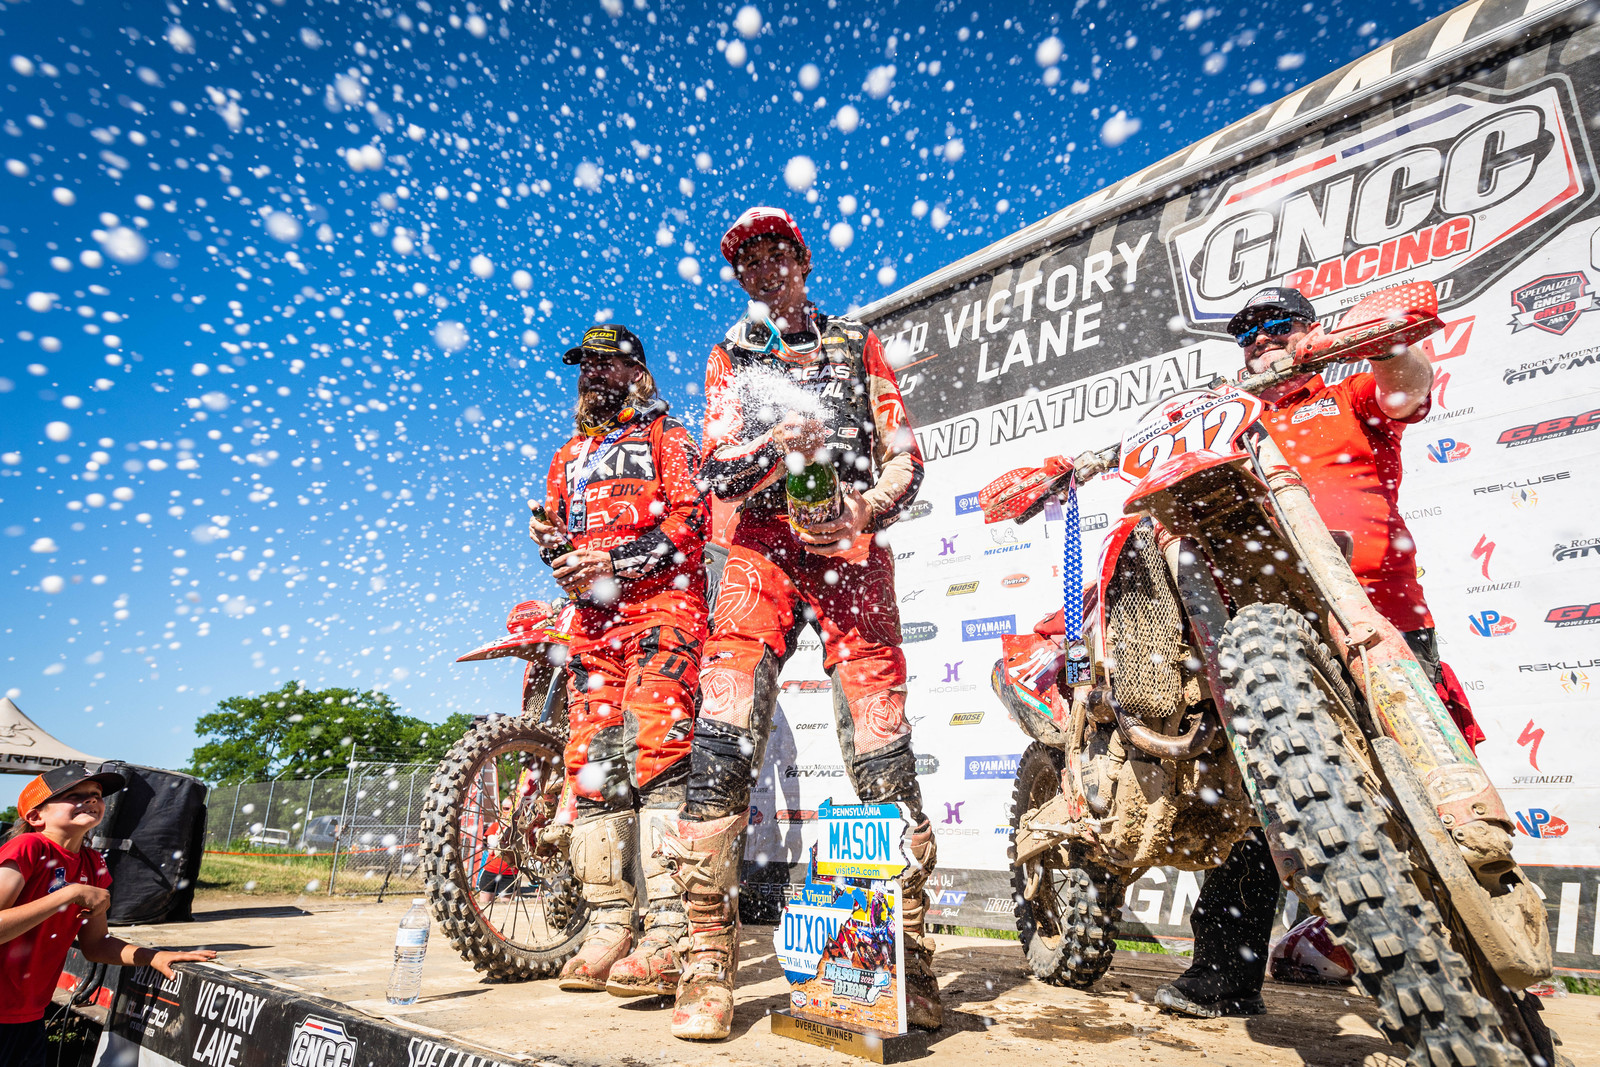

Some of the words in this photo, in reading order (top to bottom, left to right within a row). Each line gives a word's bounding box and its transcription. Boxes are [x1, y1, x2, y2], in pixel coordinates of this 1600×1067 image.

[1200, 106, 1544, 299] GNCC
[1284, 215, 1473, 300] RACING
[944, 232, 1153, 349] VICTORY
[1520, 276, 1578, 300] SPECIALIZED
[1533, 292, 1571, 310] GNCC
[977, 302, 1103, 382] LANE
[989, 349, 1218, 446] NATIONAL
[1423, 406, 1475, 424] SPECIALIZED
[1138, 400, 1247, 471] 212
[1509, 430, 1568, 447] POWERSPORTS
[1572, 425, 1596, 435] TIRES
[1426, 438, 1456, 463] VP
[1473, 471, 1571, 495] REKLUSE
[1400, 506, 1443, 521] ACING
[984, 542, 1031, 556] MICHELIN
[927, 554, 971, 567] HOOSIER
[950, 582, 977, 592] MOOSE
[1466, 580, 1521, 594] SPECIALIZED
[975, 620, 1011, 633] YAMAHA
[1468, 610, 1499, 637] VP
[929, 684, 977, 693] HOOSIER
[952, 713, 981, 722] MOOSE
[979, 760, 1017, 771] YAMAHA
[1512, 774, 1573, 784] SPECIALIZED
[832, 807, 881, 817] PENNSYLVANIA
[1515, 808, 1550, 839] VP
[829, 821, 890, 861] MASON
[835, 866, 880, 877] visitPA.com
[791, 892, 803, 901] est
[805, 890, 832, 907] Virgini
[784, 913, 837, 955] DIXON
[825, 963, 860, 983] MASON
[834, 980, 867, 999] DIXON
[194, 980, 267, 1035] VICTORY
[795, 1019, 824, 1035] OVERALL
[826, 1026, 853, 1042] WINNER
[192, 1023, 242, 1067] LANE
[292, 1032, 353, 1067] GNCC
